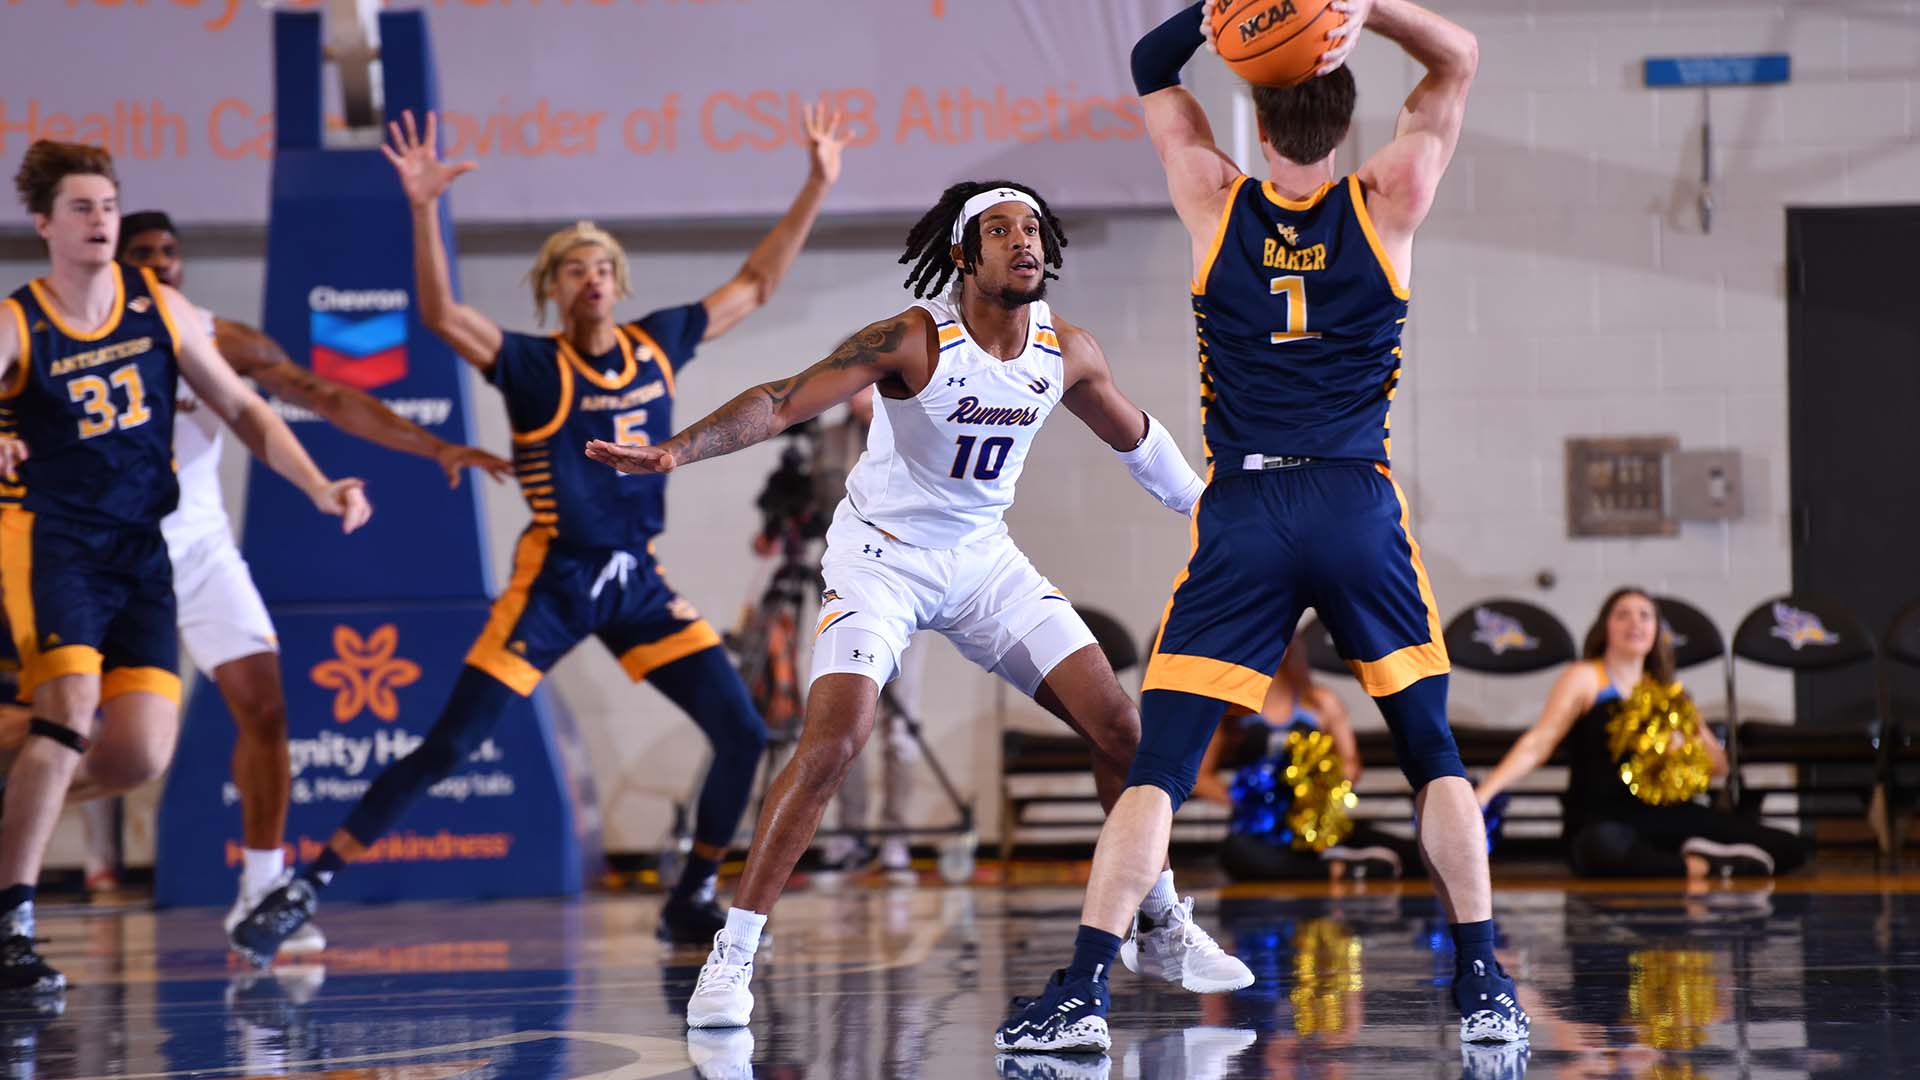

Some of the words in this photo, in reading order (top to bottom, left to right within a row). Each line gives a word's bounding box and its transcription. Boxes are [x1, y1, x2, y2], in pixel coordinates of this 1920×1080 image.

[1239, 0, 1298, 43] NCAA
[0, 95, 189, 160] Health
[439, 95, 607, 158] ovider
[623, 92, 681, 156] of
[700, 87, 880, 151] CSUB
[894, 80, 1142, 145] Athletics
[1263, 238, 1326, 271] BAKER
[309, 286, 408, 312] Chevron
[1270, 275, 1322, 344] 1
[67, 362, 152, 440] 31
[946, 396, 1040, 426] Runners
[949, 434, 1015, 481] 10
[287, 729, 373, 776] gnity
